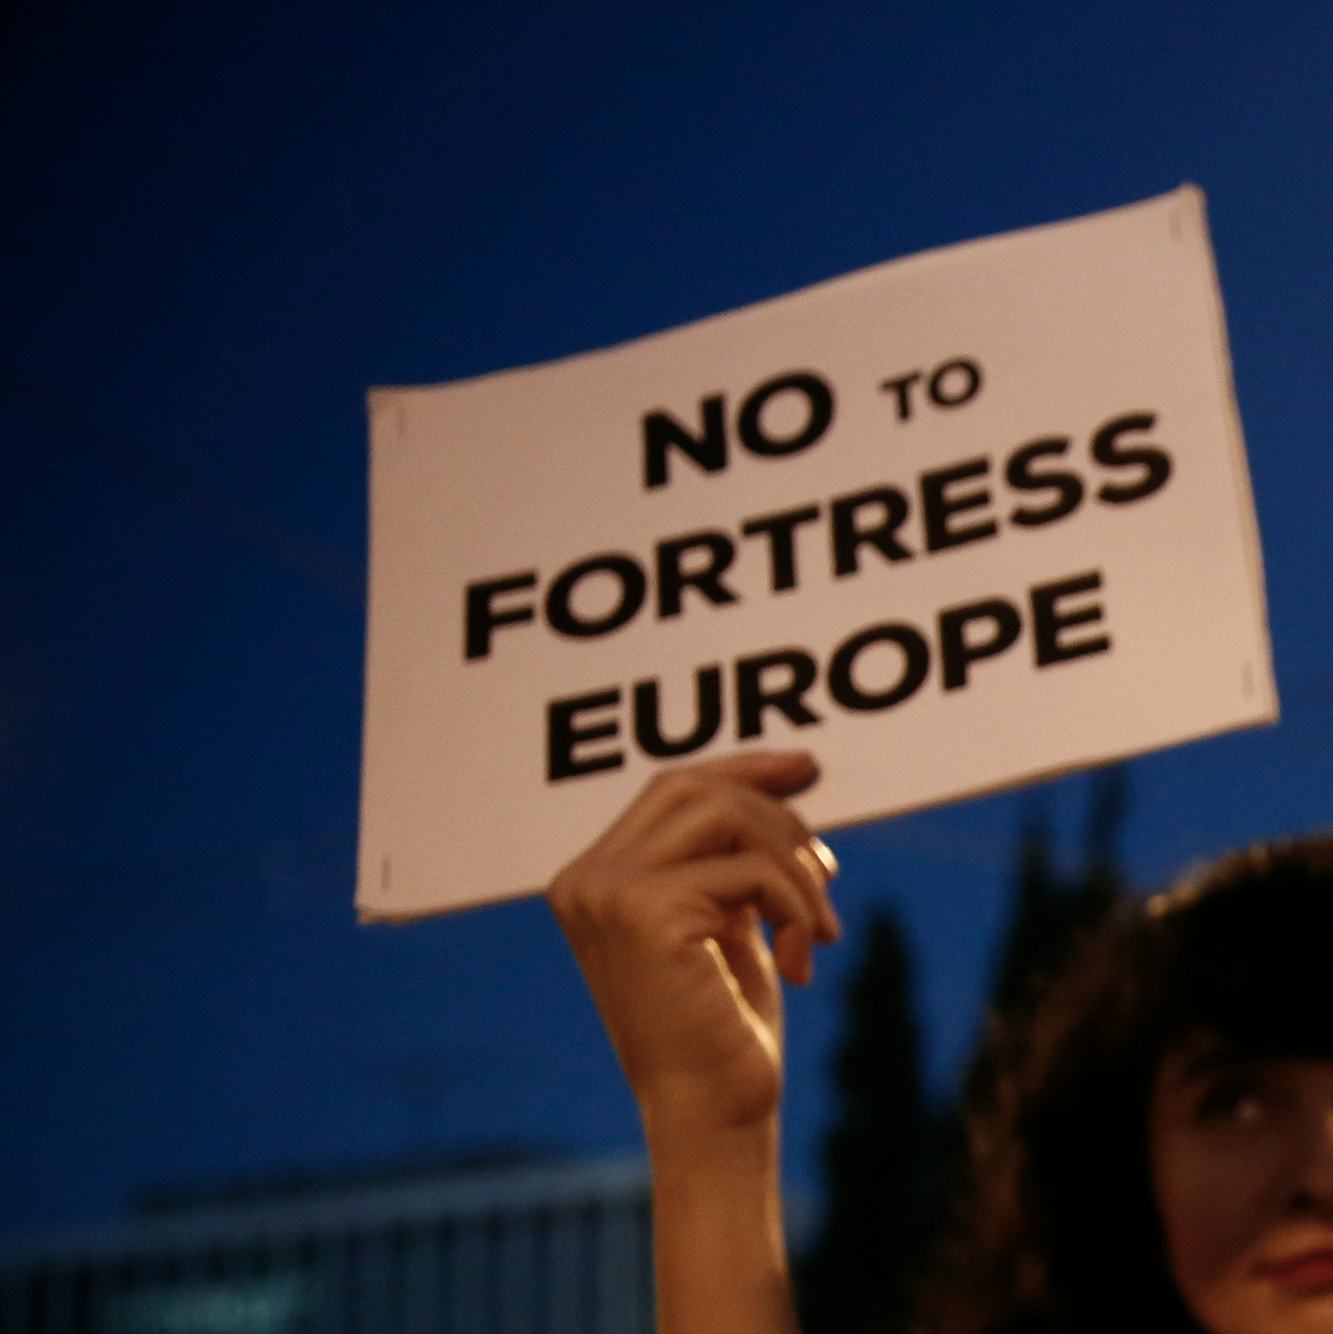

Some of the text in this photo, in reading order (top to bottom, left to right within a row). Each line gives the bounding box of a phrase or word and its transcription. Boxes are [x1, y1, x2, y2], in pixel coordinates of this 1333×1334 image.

[640, 357, 984, 491] NO TO
[462, 412, 1174, 664] FORTRESS
[544, 570, 1112, 785] EUROPE
